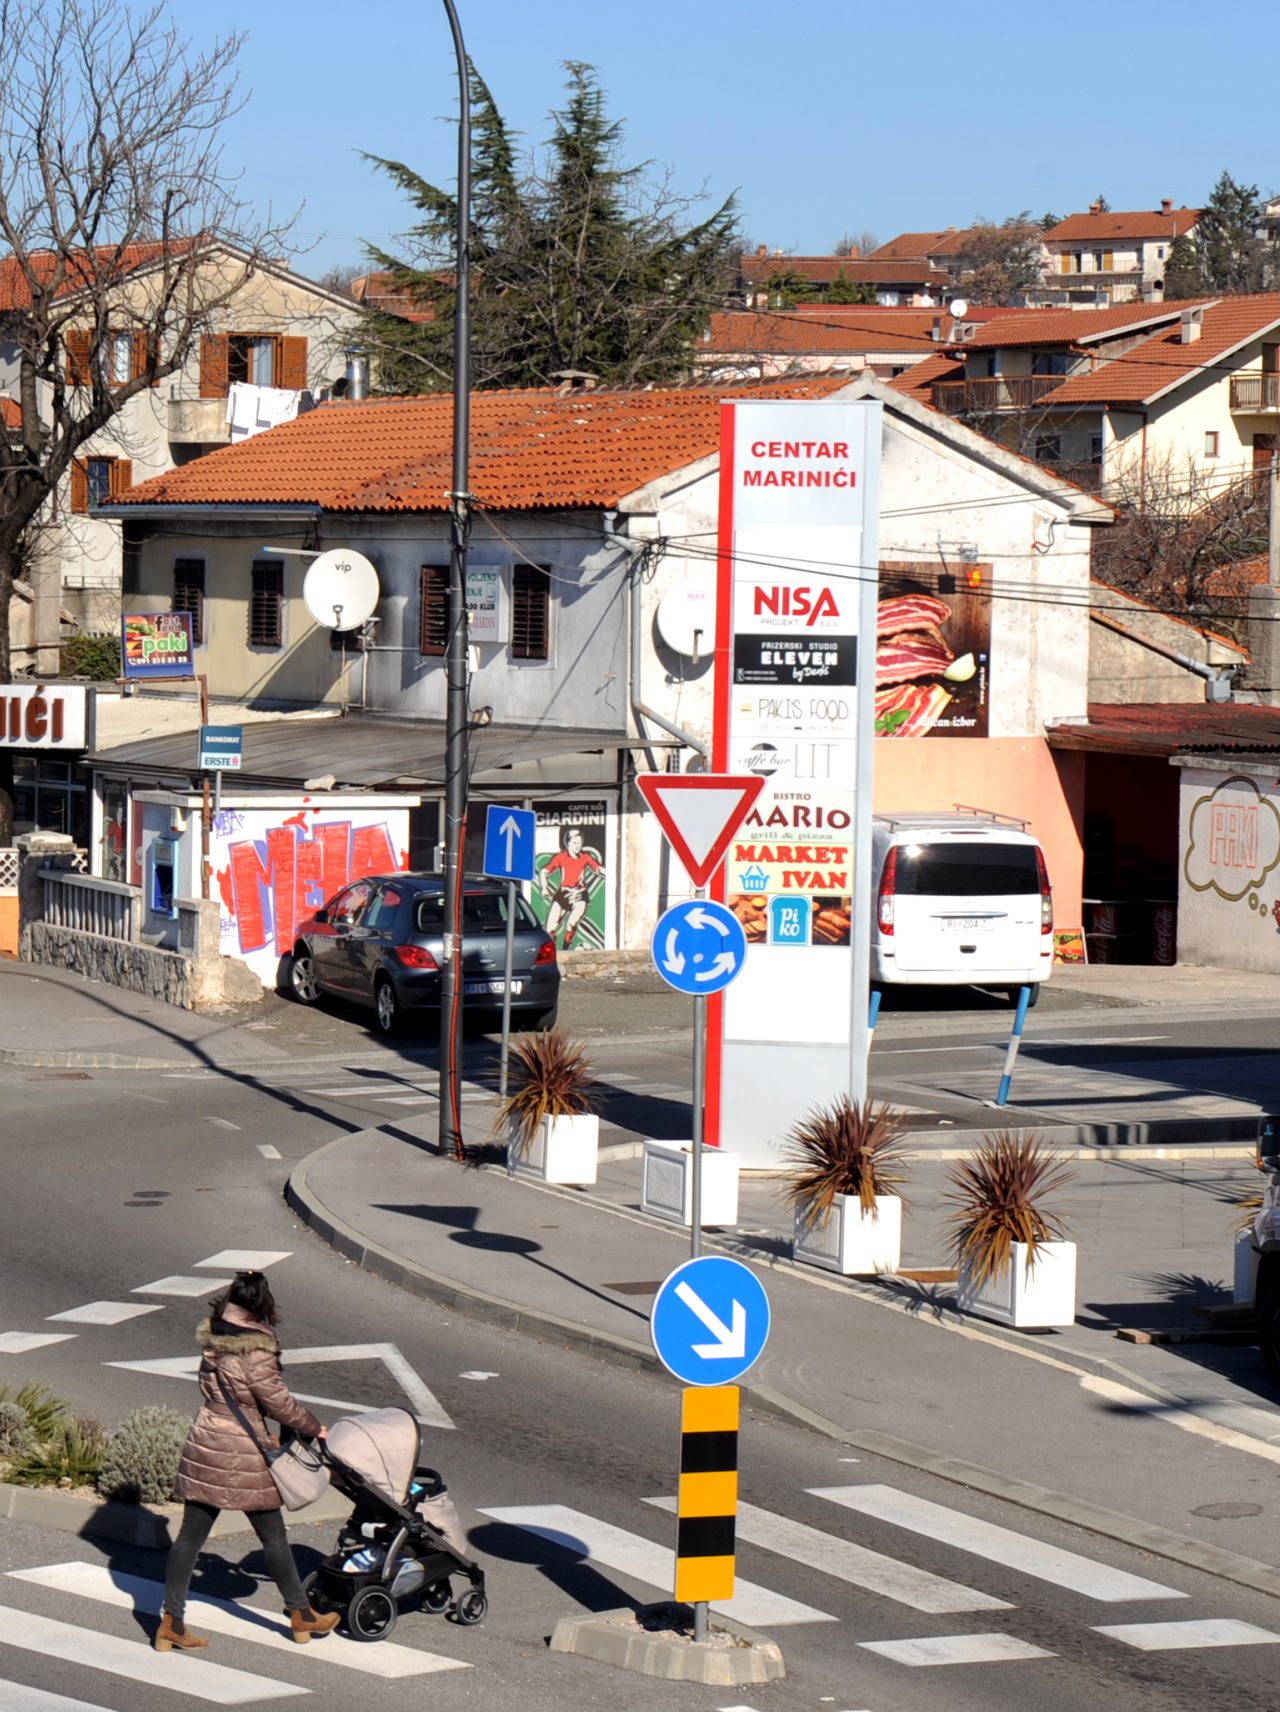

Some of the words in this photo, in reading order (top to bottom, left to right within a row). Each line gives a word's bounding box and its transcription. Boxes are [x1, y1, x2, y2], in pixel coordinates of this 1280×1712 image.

[750, 441, 849, 459] CENTAR
[743, 467, 856, 488] MARINIĆI
[334, 560, 352, 573] vip
[753, 585, 840, 627] NISA
[760, 618, 799, 627] PROJEKT
[142, 631, 188, 658] paki
[761, 641, 803, 650] FRIZERSKI
[808, 642, 838, 651] STUDIO
[761, 651, 838, 666] ELEVEN
[792, 666, 804, 683] by
[810, 699, 849, 722] FOOD
[952, 715, 977, 727] izbor
[205, 735, 240, 744] BANKOMAT
[204, 756, 232, 766] ERSTE
[795, 743, 840, 778] LIT
[773, 792, 812, 801] BISTRO
[535, 811, 605, 826] GIARDINI
[750, 831, 778, 840] grill
[798, 832, 832, 841] pizza
[735, 844, 849, 864] MARKET
[782, 870, 848, 889] IVAN
[781, 907, 799, 922] pi
[779, 918, 801, 936] ko
